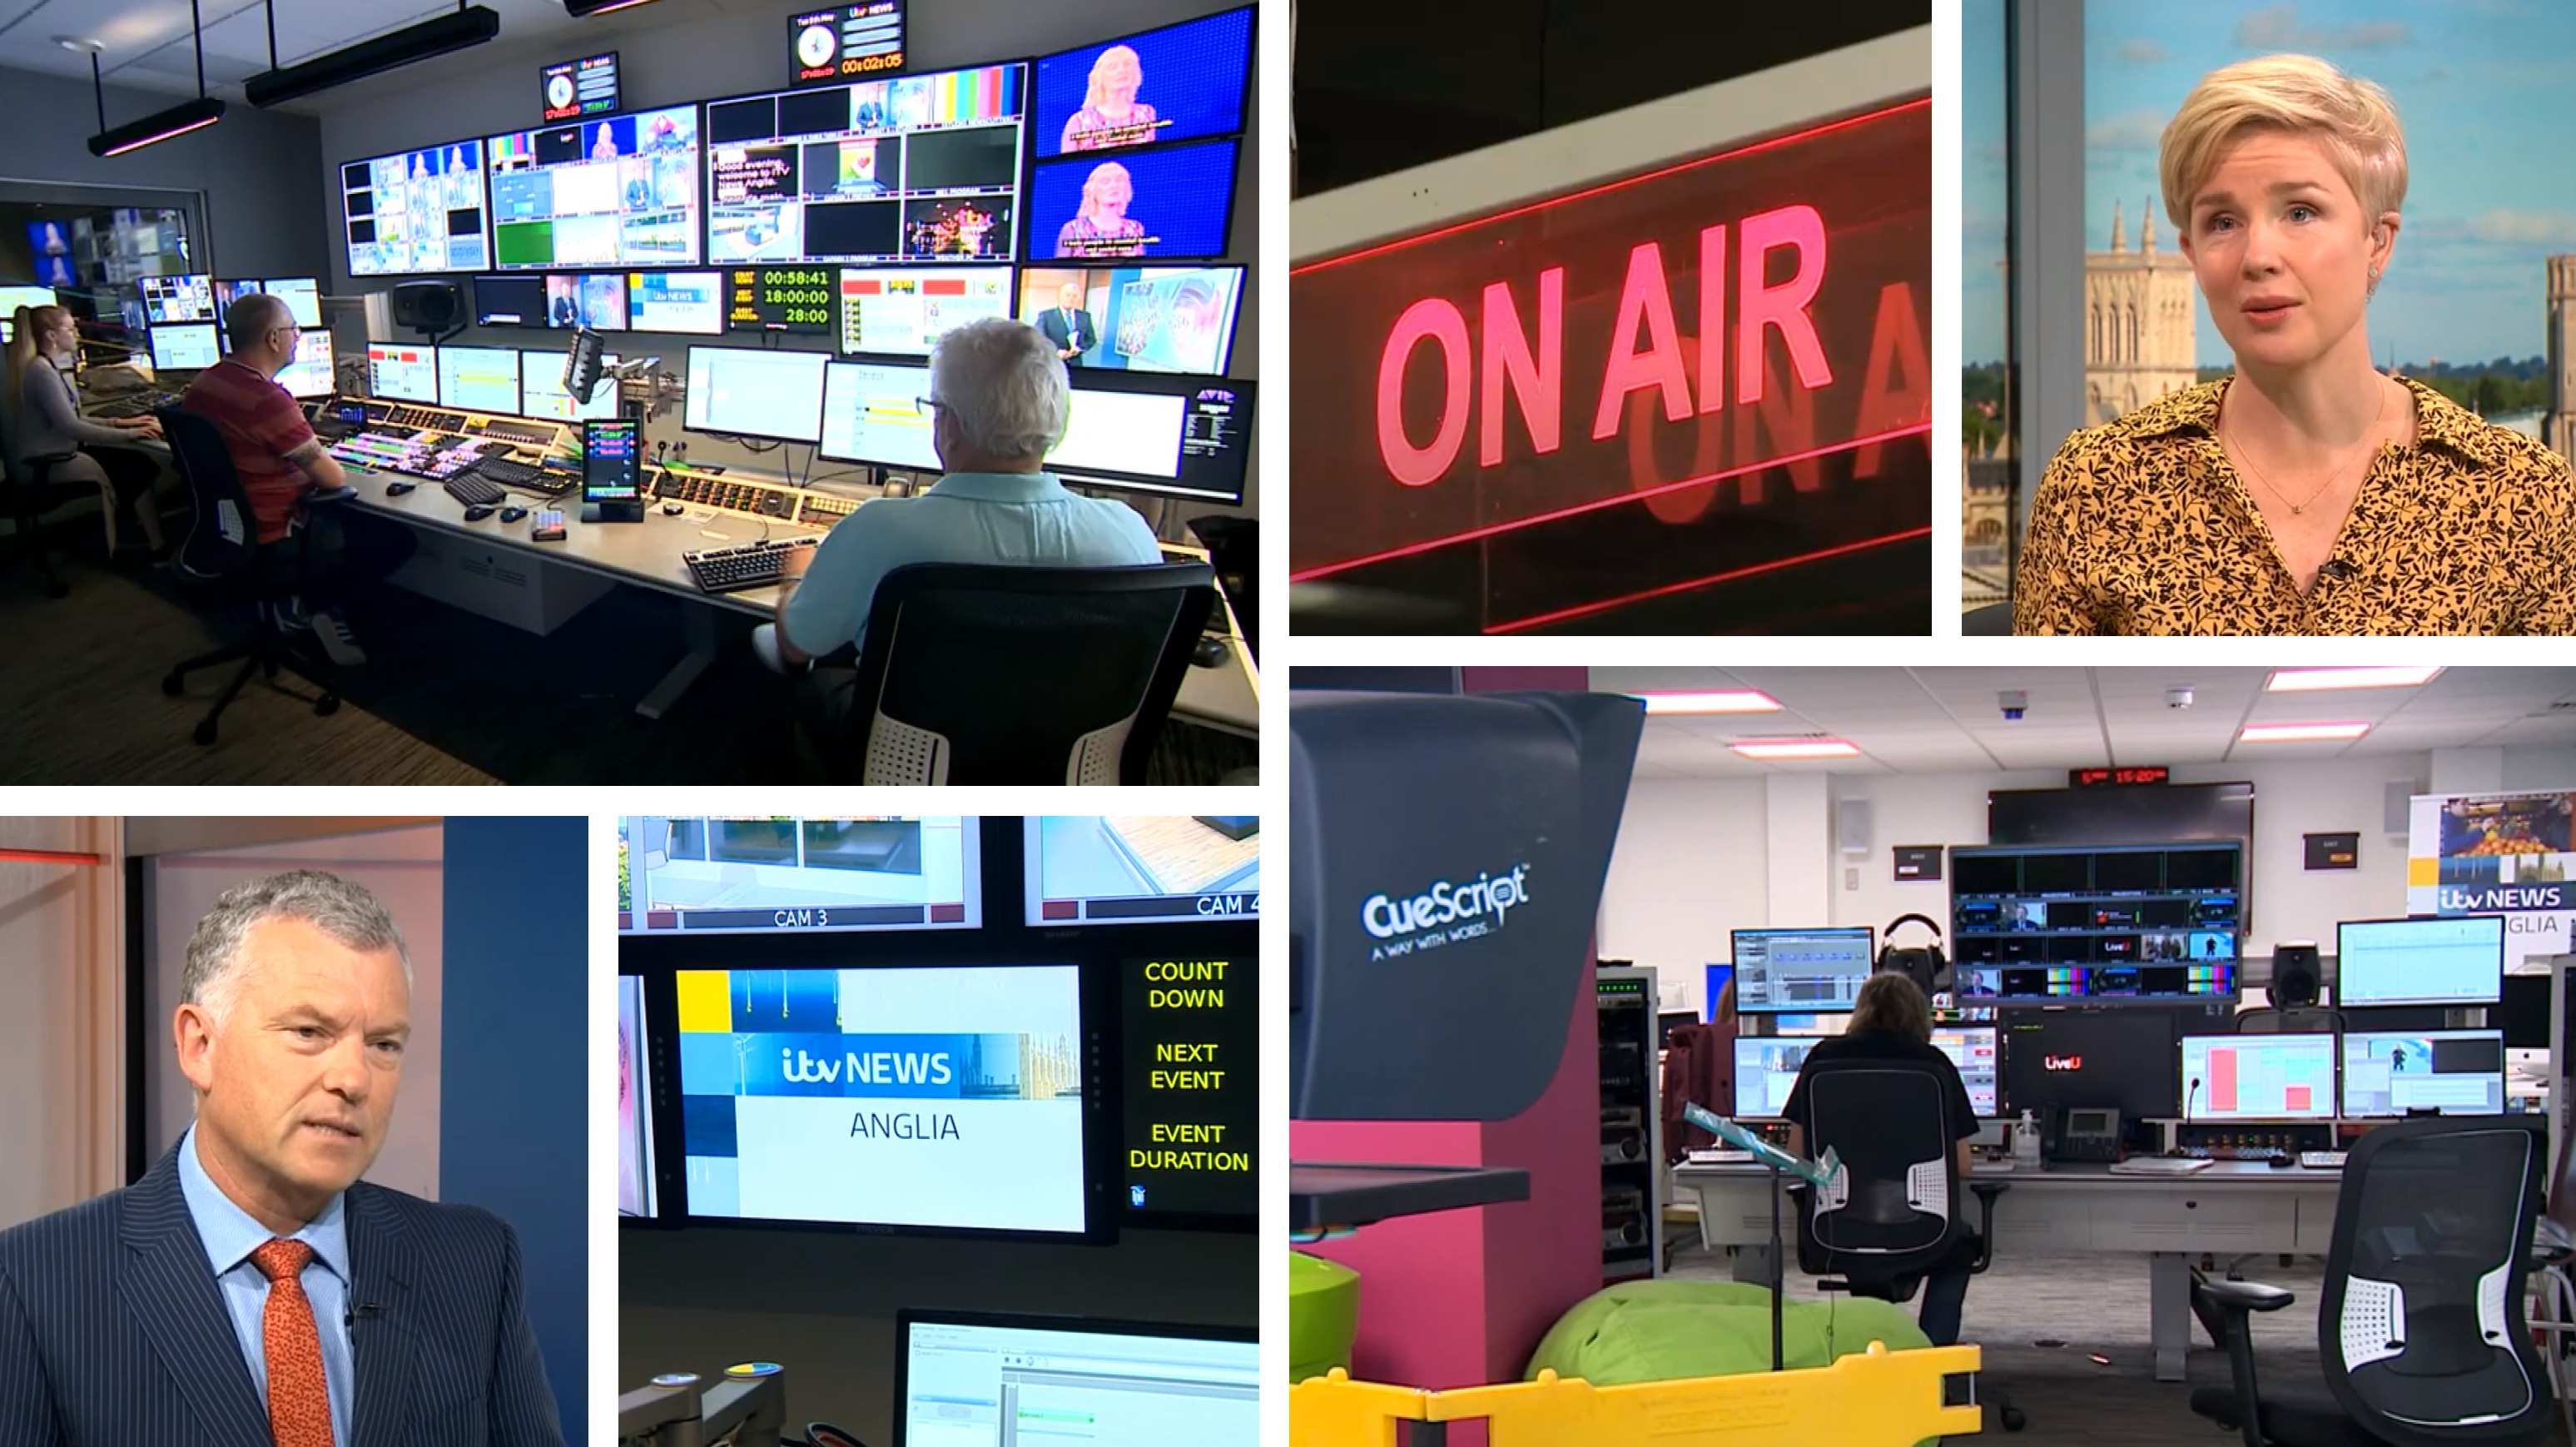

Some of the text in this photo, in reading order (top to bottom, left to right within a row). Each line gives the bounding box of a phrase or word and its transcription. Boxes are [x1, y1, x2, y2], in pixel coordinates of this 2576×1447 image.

[764, 271, 828, 285] 00:58:41
[764, 290, 829, 303] 18:00:00
[786, 309, 828, 323] 28:00
[1377, 204, 1834, 486] ON AIR
[1197, 895, 1242, 915] CAM
[1362, 865, 1529, 938] CueScript
[2440, 887, 2561, 909] itv NEWS
[775, 909, 827, 926] CAM 3
[2508, 917, 2558, 933] GLIA
[1372, 947, 1385, 962] A
[1385, 938, 1413, 957] WAY
[1416, 933, 1447, 951] WITH
[1145, 962, 1229, 982] COUNT
[1149, 989, 1223, 1008] DOWN
[1156, 1043, 1218, 1063] NEXT
[2045, 1055, 2081, 1070] LiveU
[782, 1047, 951, 1086] itv NEWS
[1151, 1071, 1224, 1091] EVENT
[850, 1112, 960, 1141] ANGLIA
[1151, 1124, 1225, 1144] EVENT
[1130, 1150, 1249, 1172] DURATION
